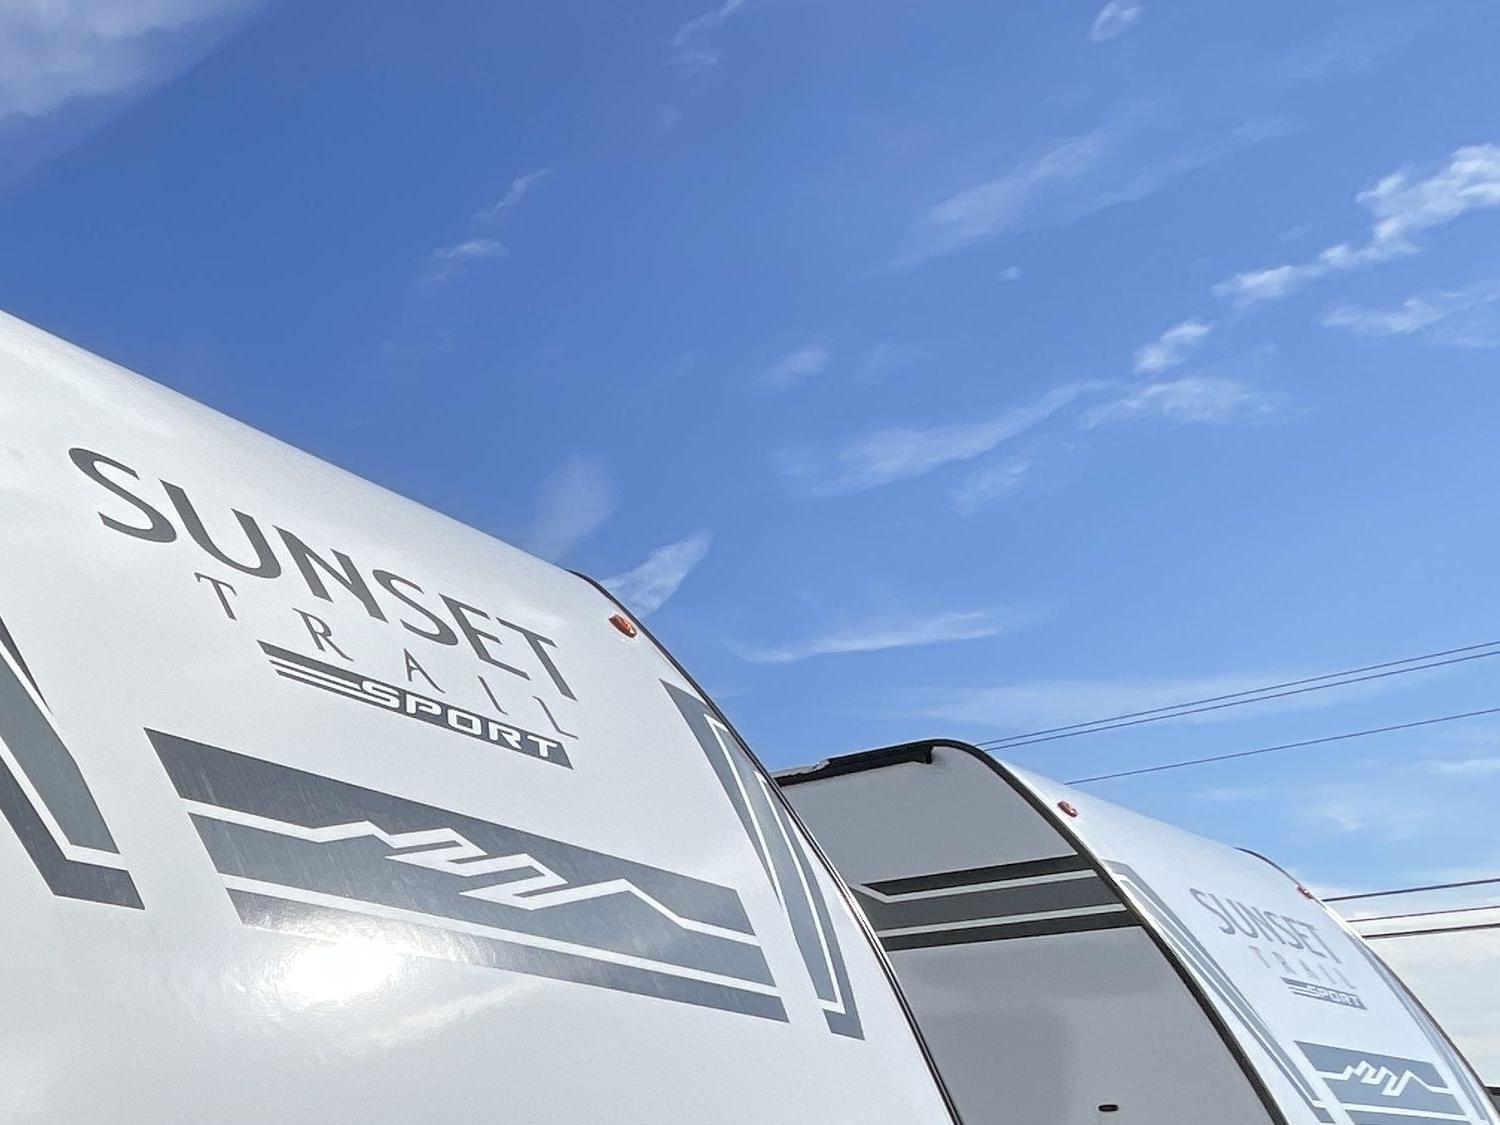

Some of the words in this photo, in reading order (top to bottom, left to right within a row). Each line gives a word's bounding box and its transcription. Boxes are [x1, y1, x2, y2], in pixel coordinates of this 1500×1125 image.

[68, 447, 579, 702] SUNSET
[194, 572, 579, 739] TRAIL
[361, 680, 558, 758] SPORT
[1189, 888, 1342, 964] SUNSET
[1248, 945, 1357, 990] TRAIL
